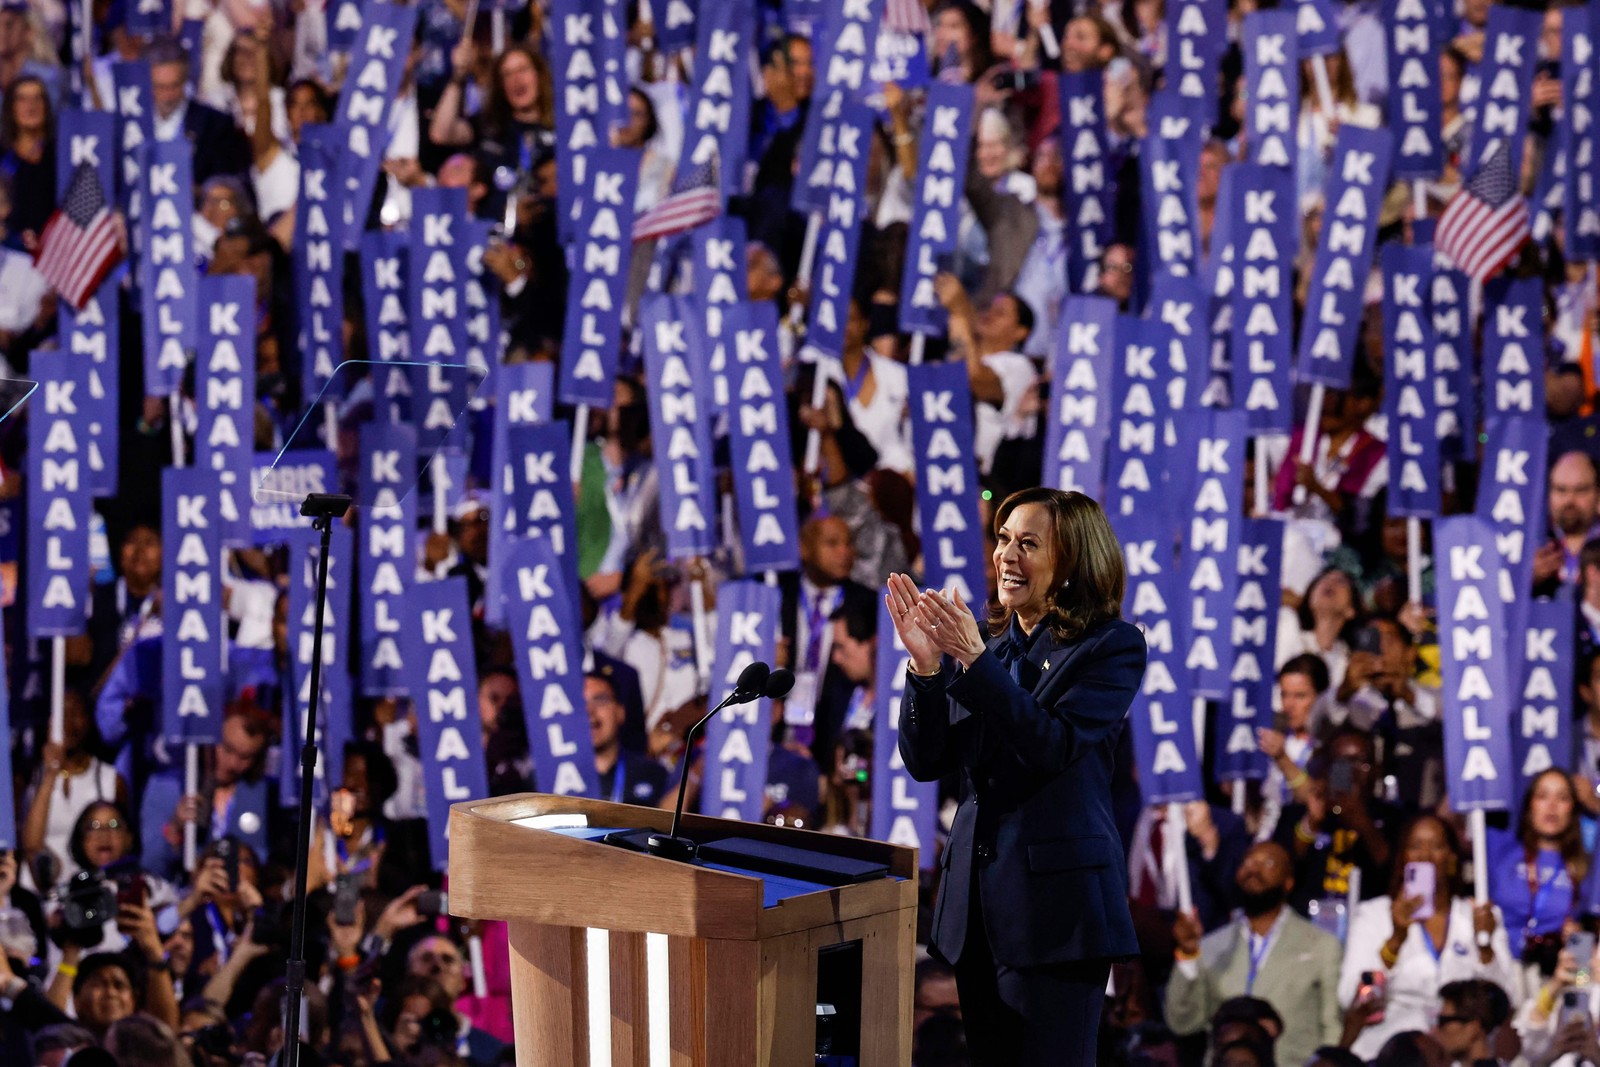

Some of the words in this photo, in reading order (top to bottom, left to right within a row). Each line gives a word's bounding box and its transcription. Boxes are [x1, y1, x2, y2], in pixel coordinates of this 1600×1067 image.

[565, 13, 598, 220] KAMA
[691, 29, 740, 165] KAMA
[1178, 0, 1207, 97] ALA
[1255, 34, 1290, 166] KAMA
[1394, 0, 1432, 156] AMALA
[1479, 32, 1524, 162] KAM
[149, 163, 187, 370] KAMALA
[304, 168, 335, 378] KAMALA
[573, 171, 625, 381] KAMALA
[817, 123, 860, 332] KAMALA
[913, 106, 959, 308] KAMALA
[1152, 160, 1192, 277] KAM
[1243, 190, 1280, 410] KAMALA
[1311, 150, 1375, 361] KAMALA
[373, 257, 410, 424] KAMA
[421, 213, 457, 429] KAMALA
[1059, 322, 1099, 492] KAMAL
[1393, 274, 1427, 492] KAMALA
[1496, 305, 1532, 411] KAM
[42, 381, 78, 608] KAMALA
[655, 321, 706, 531] KAMALA
[735, 329, 785, 546] KAMALA
[1119, 345, 1155, 515] KAMA
[1492, 448, 1529, 602] KAM
[175, 495, 211, 716] KAMALA
[369, 450, 405, 670] KAMALA
[1186, 438, 1230, 670] KAMALA
[1227, 544, 1268, 753] KAMALA
[421, 608, 470, 800] KAMAL
[517, 564, 587, 795] KAMALA
[1450, 545, 1497, 781] KAMALA
[1521, 628, 1559, 776] KAMA
